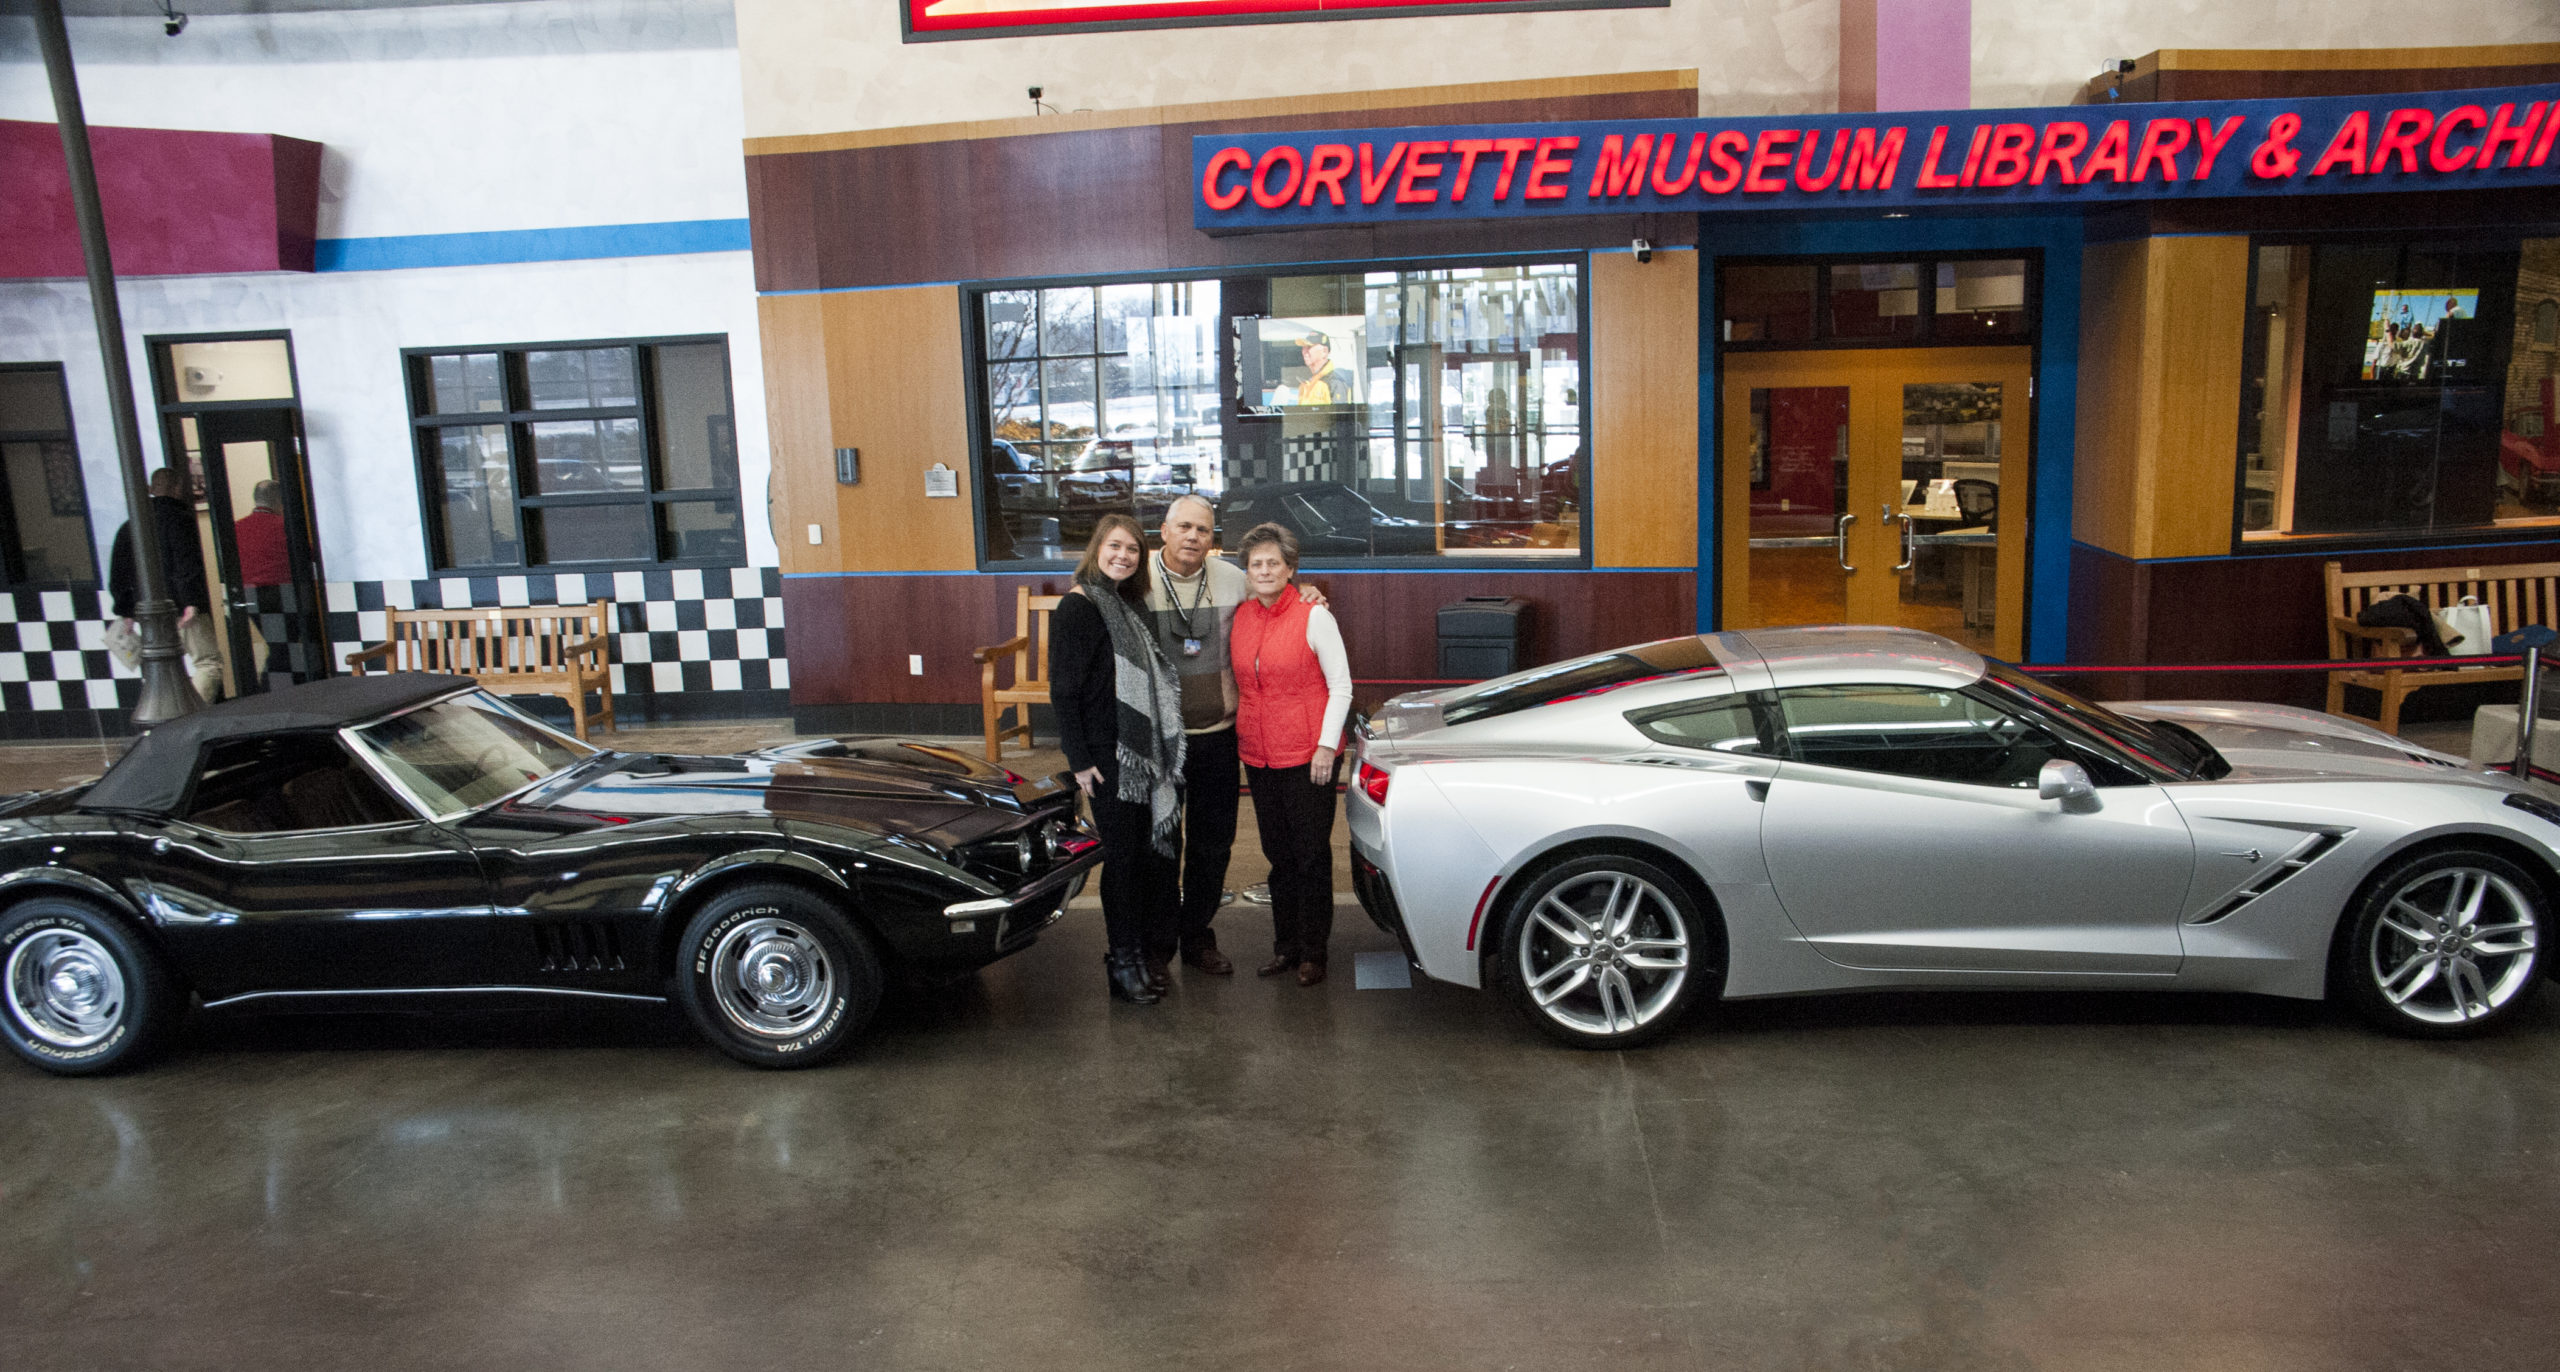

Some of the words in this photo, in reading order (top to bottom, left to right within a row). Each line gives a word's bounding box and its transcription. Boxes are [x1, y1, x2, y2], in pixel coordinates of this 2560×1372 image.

[1202, 136, 1580, 211] CORVETTE
[1588, 126, 1908, 197] MUSEUM
[1916, 115, 2247, 189] LIBRARY
[2251, 112, 2302, 179] &
[2310, 99, 2560, 177] ARCHI
[696, 906, 780, 974] BFGoodrich
[776, 1042, 804, 1053] T/A
[807, 997, 846, 1045] Radial
